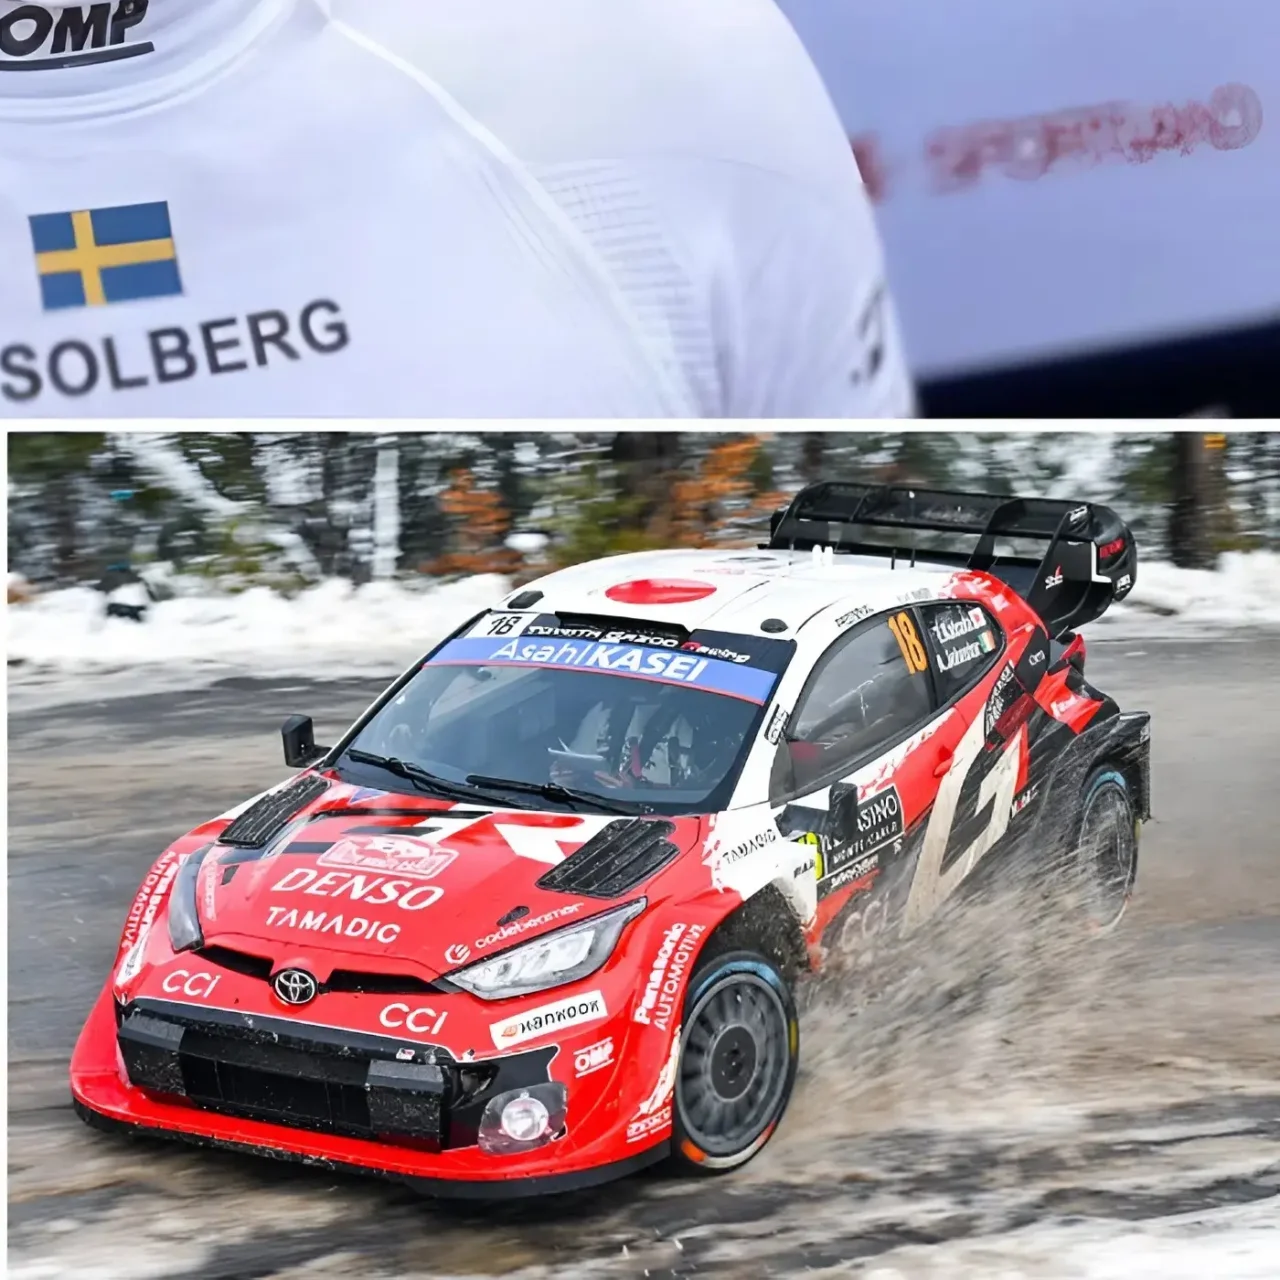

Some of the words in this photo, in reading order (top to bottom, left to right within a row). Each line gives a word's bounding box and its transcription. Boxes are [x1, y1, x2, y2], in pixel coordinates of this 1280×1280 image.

[0, 298, 351, 402] SOLBERG
[887, 610, 929, 676] 18
[270, 866, 446, 912] DENSO
[264, 906, 403, 945] TAMADIC
[161, 968, 223, 999] CCI
[379, 1002, 449, 1036] CCI
[574, 1040, 615, 1073] OMP
